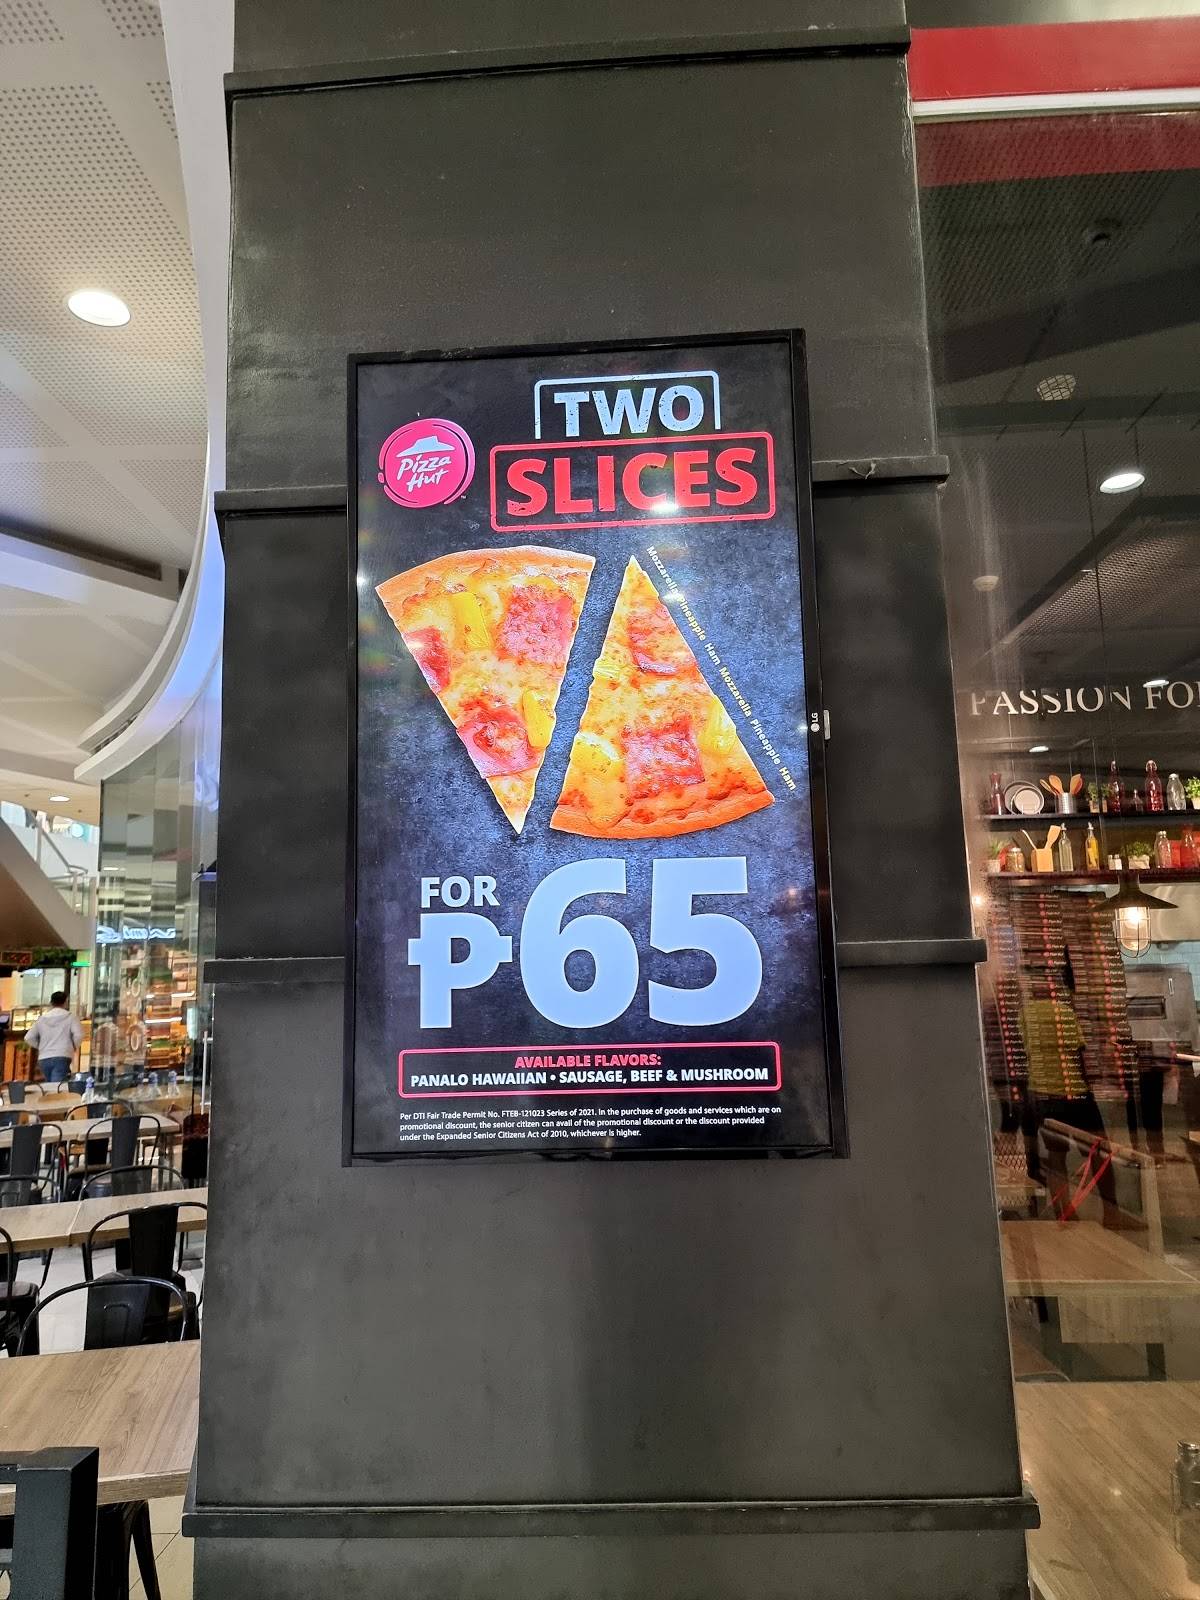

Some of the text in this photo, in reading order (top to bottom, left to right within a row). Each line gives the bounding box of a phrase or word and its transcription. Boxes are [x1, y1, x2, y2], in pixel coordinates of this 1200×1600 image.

[554, 384, 704, 437] TWO
[397, 454, 451, 480] Pizza
[406, 469, 448, 492] Hut
[507, 447, 758, 516] SLICES
[647, 546, 796, 791] Mozzarella Pineapple Ham Mozzarella Pineapple Ham
[1145, 681, 1200, 710] FO
[812, 713, 818, 723] LG
[421, 875, 500, 908] FOR
[515, 1054, 661, 1068] AVAILABLE FLAVORS:
[411, 1068, 768, 1087] PANALO HAWAIIAN SAUSAGE, BEEF & MUSHROOM
[400, 1112, 412, 1120] Per
[502, 1110, 545, 1118] FTEB-121023
[547, 1109, 568, 1117] Series
[569, 1108, 578, 1116] of
[621, 1107, 653, 1116] purchase
[664, 1107, 687, 1116] goods
[734, 1106, 756, 1114] which
[400, 1122, 443, 1131] promotional
[445, 1121, 478, 1130] discount,
[493, 1120, 515, 1128] senior
[517, 1120, 540, 1128] citizen
[597, 1118, 641, 1127] promotional
[643, 1117, 674, 1125] discount
[732, 1116, 764, 1125] provided
[400, 1133, 421, 1141] under
[437, 1132, 472, 1141] Expanded
[498, 1131, 525, 1139] Citizens
[541, 1130, 549, 1138] of
[550, 1130, 569, 1138] 2010,
[616, 1129, 641, 1138] higher.
